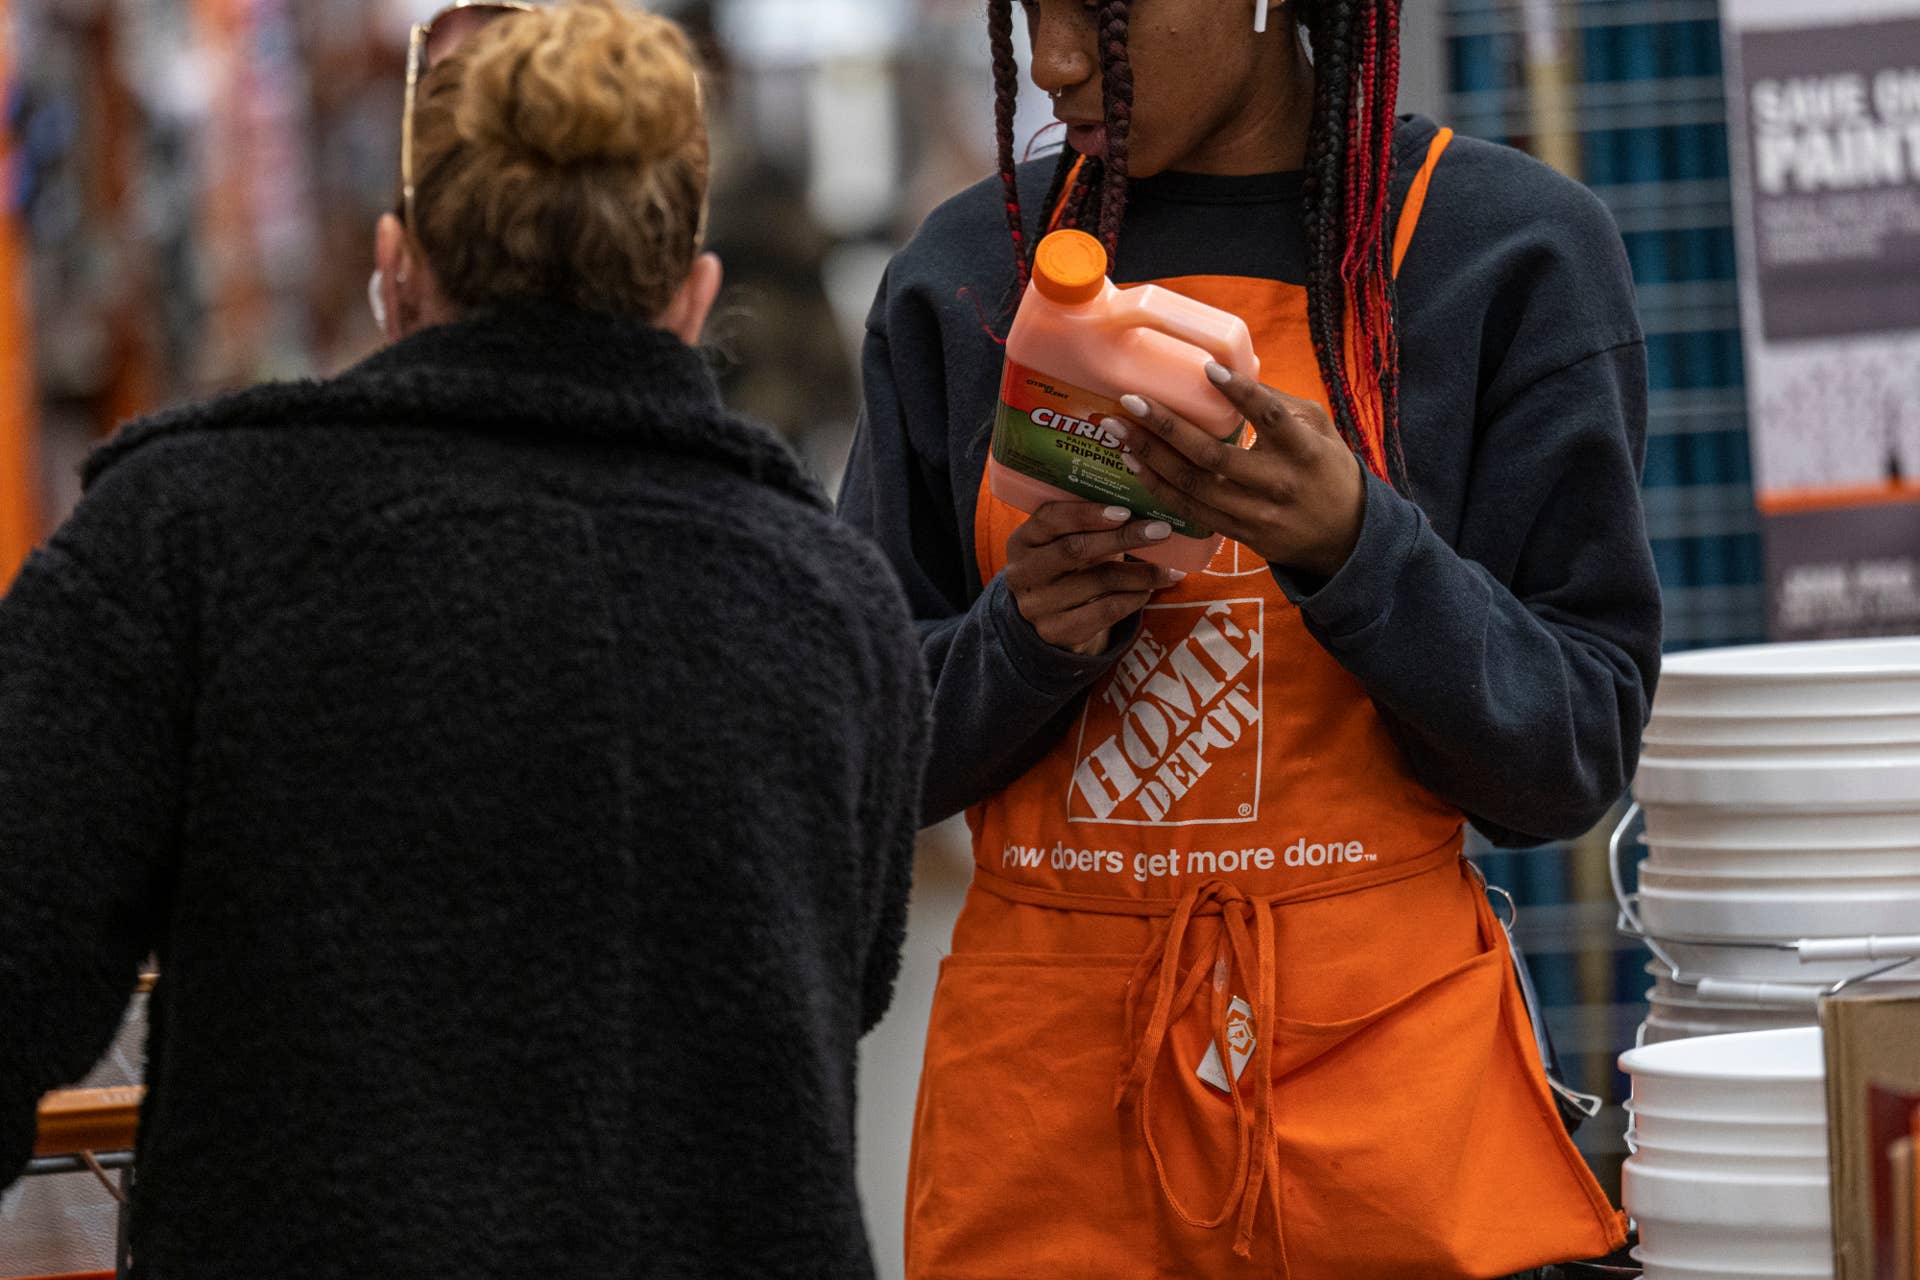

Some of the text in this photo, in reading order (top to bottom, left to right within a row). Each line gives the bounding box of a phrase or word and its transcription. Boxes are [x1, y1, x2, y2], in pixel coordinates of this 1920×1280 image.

[1753, 75, 1866, 124] SAVE
[1030, 407, 1131, 453] CITRIS
[1056, 439, 1123, 471] STRIPPING
[1103, 627, 1168, 717] THE
[1074, 600, 1263, 820] HOME
[1136, 682, 1260, 823] DEPOT
[1051, 840, 1124, 873] doers
[1133, 849, 1181, 882] get
[1187, 848, 1275, 874] more
